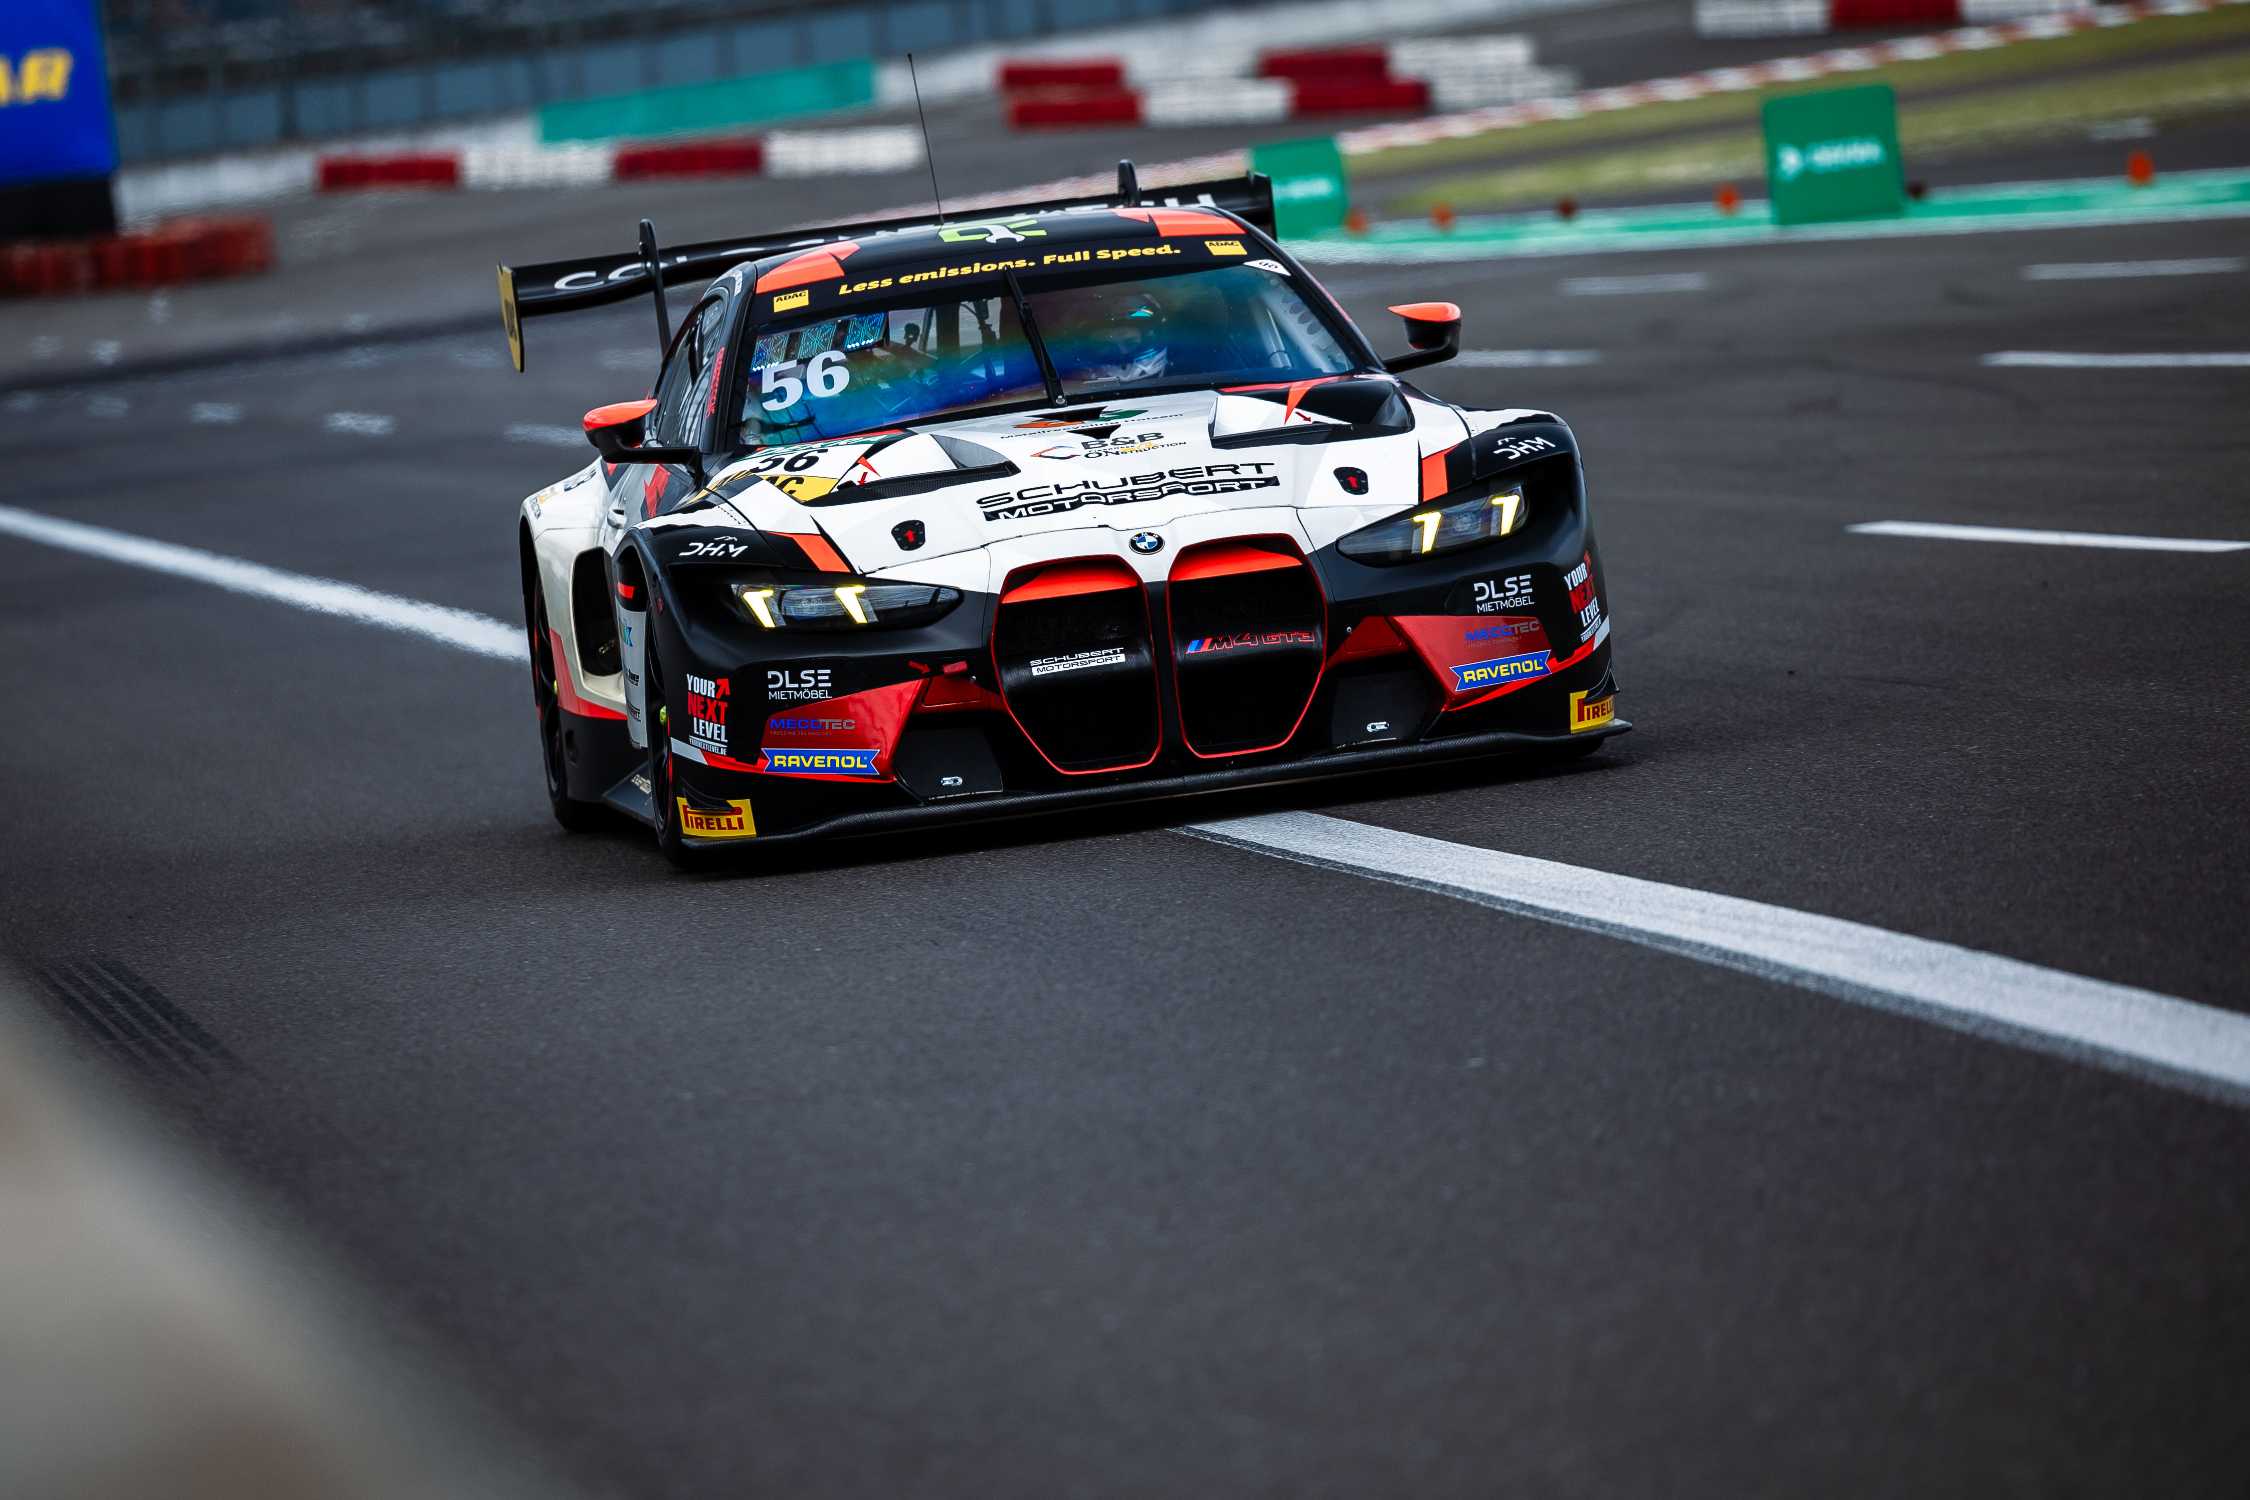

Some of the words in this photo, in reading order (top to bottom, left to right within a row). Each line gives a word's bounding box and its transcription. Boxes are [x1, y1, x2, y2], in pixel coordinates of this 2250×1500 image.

[838, 278, 893, 295] Less
[899, 259, 1036, 284] emissions.
[1043, 250, 1091, 265] Full
[1096, 244, 1182, 260] Speed.
[775, 291, 807, 303] ADAC
[761, 350, 850, 411] 56
[1080, 432, 1165, 450] B&B
[749, 448, 829, 474] 56
[976, 462, 1276, 509] SCHUBERT
[997, 480, 1267, 520] MOTORSPORT
[1473, 574, 1533, 602] DLSE
[1563, 562, 1588, 591] YOUR
[1476, 595, 1535, 614] MIETMÖBEL
[1580, 596, 1600, 628] LEVEL
[1030, 647, 1124, 667] SCHUBERT
[1036, 655, 1122, 674] MOTORSPORT
[767, 669, 832, 688] DLSE
[1463, 659, 1544, 683] RAVENOL
[686, 673, 716, 698] YOUR
[768, 688, 833, 700] MIETMÖBEL
[687, 691, 729, 724] NEXT
[693, 716, 729, 743] LEVEL
[773, 755, 868, 769] RAVENOL
[682, 804, 745, 831] PIRELLI
